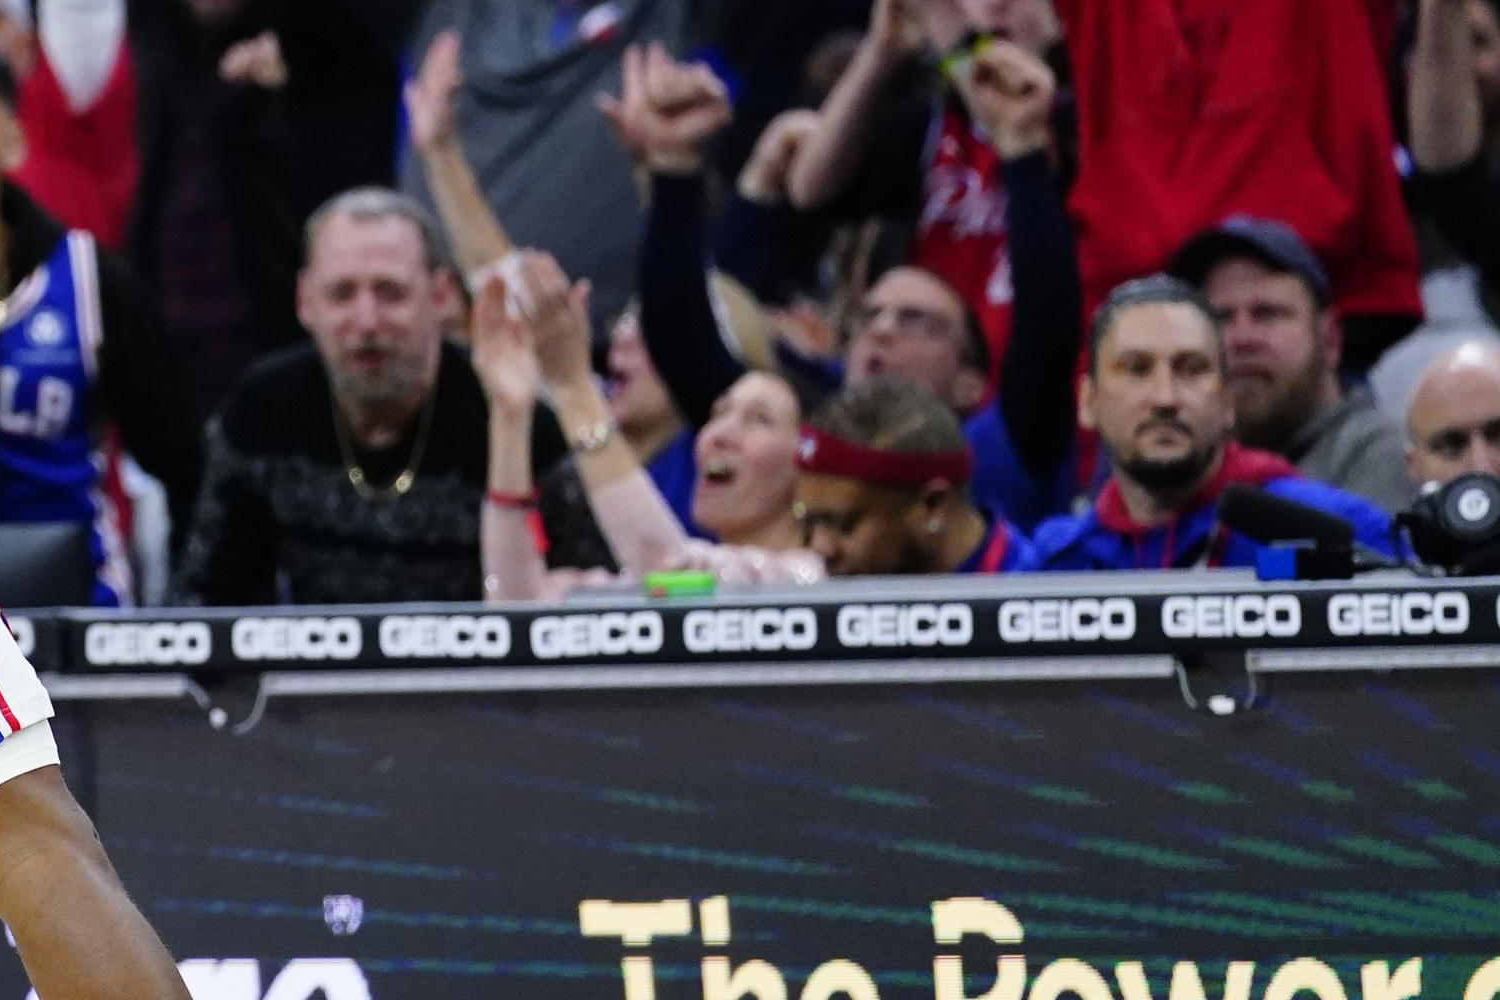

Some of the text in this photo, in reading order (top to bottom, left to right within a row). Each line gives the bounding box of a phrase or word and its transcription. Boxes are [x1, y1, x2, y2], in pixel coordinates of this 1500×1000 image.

[530, 610, 664, 658] GEICO
[683, 607, 818, 652] GEICO
[837, 603, 973, 647] GEICO
[998, 597, 1136, 642] GEICO
[1161, 594, 1302, 638] GEICO
[1327, 591, 1470, 636] GEICO
[85, 621, 212, 664] GEICO
[232, 616, 362, 659] GEICO
[379, 615, 511, 657] GEICO
